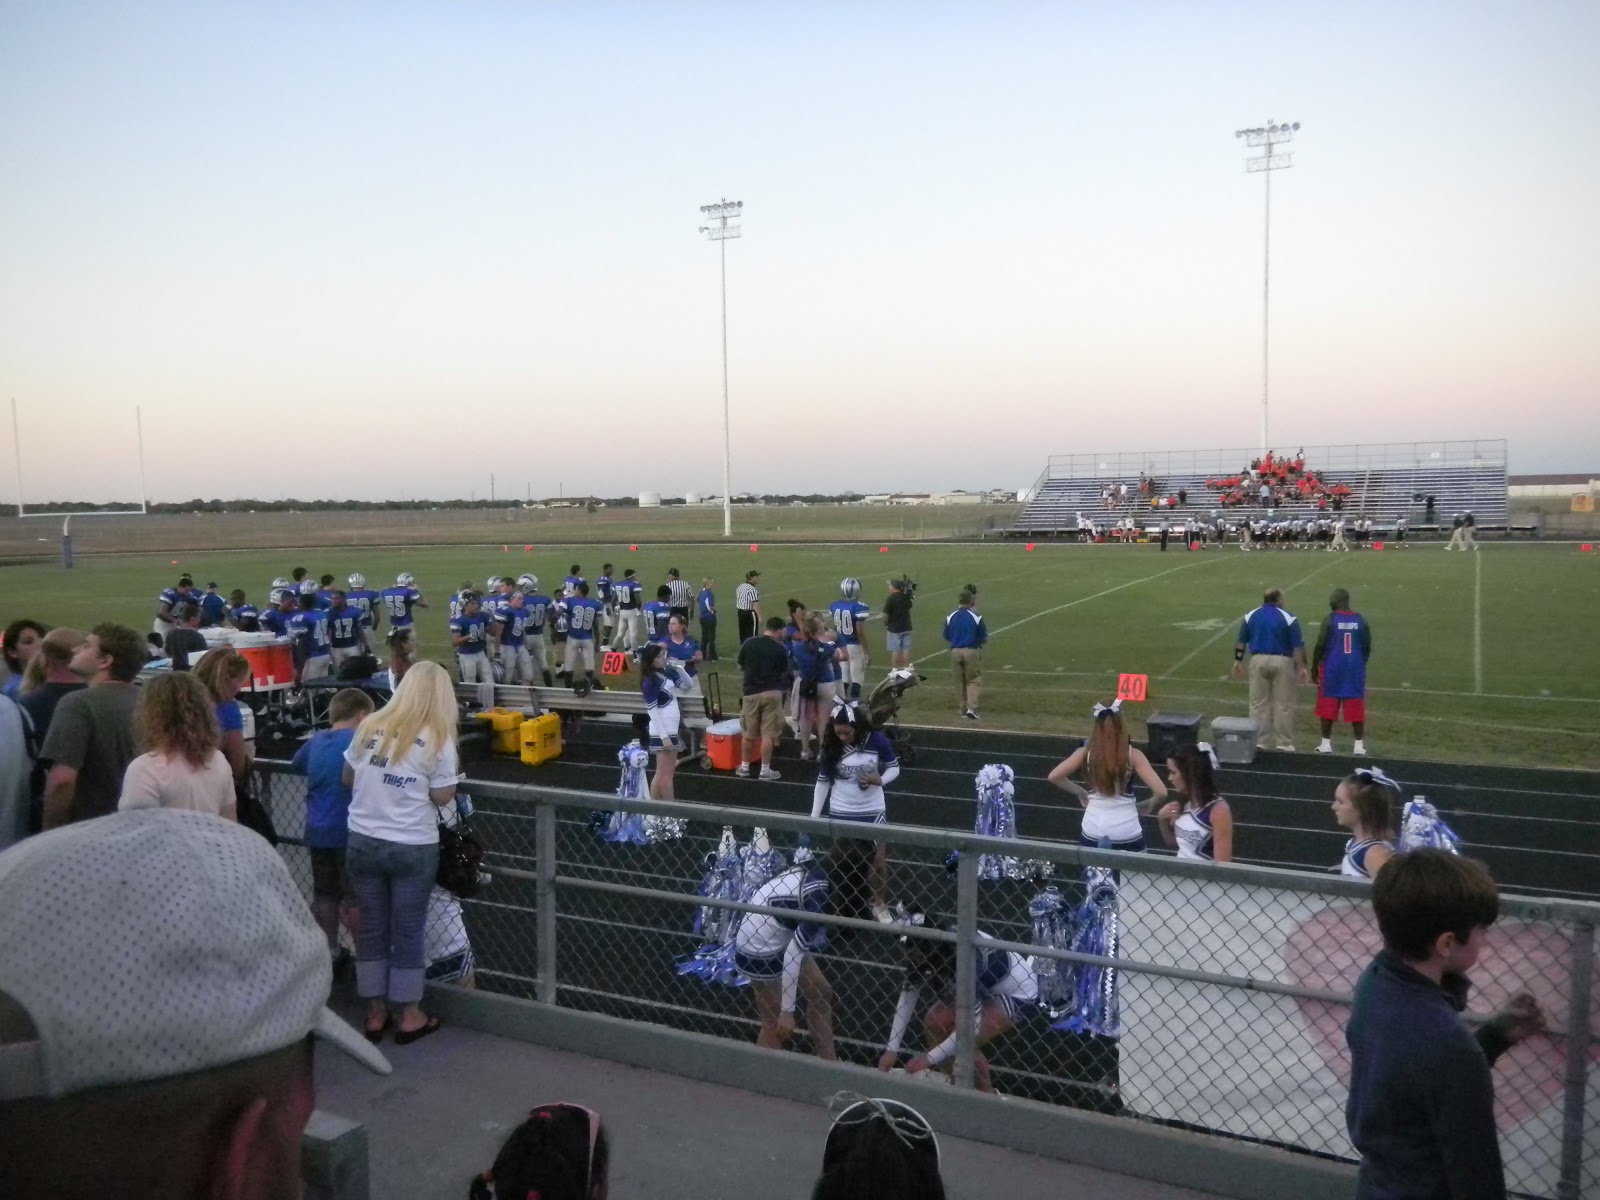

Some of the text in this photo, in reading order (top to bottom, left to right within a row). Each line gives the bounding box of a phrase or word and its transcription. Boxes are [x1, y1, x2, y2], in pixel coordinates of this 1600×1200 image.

[385, 595, 406, 617] 55
[334, 618, 353, 639] 17
[572, 605, 596, 630] 39
[1344, 632, 1351, 654] 1
[603, 653, 621, 673] 50
[1120, 676, 1143, 699] 40
